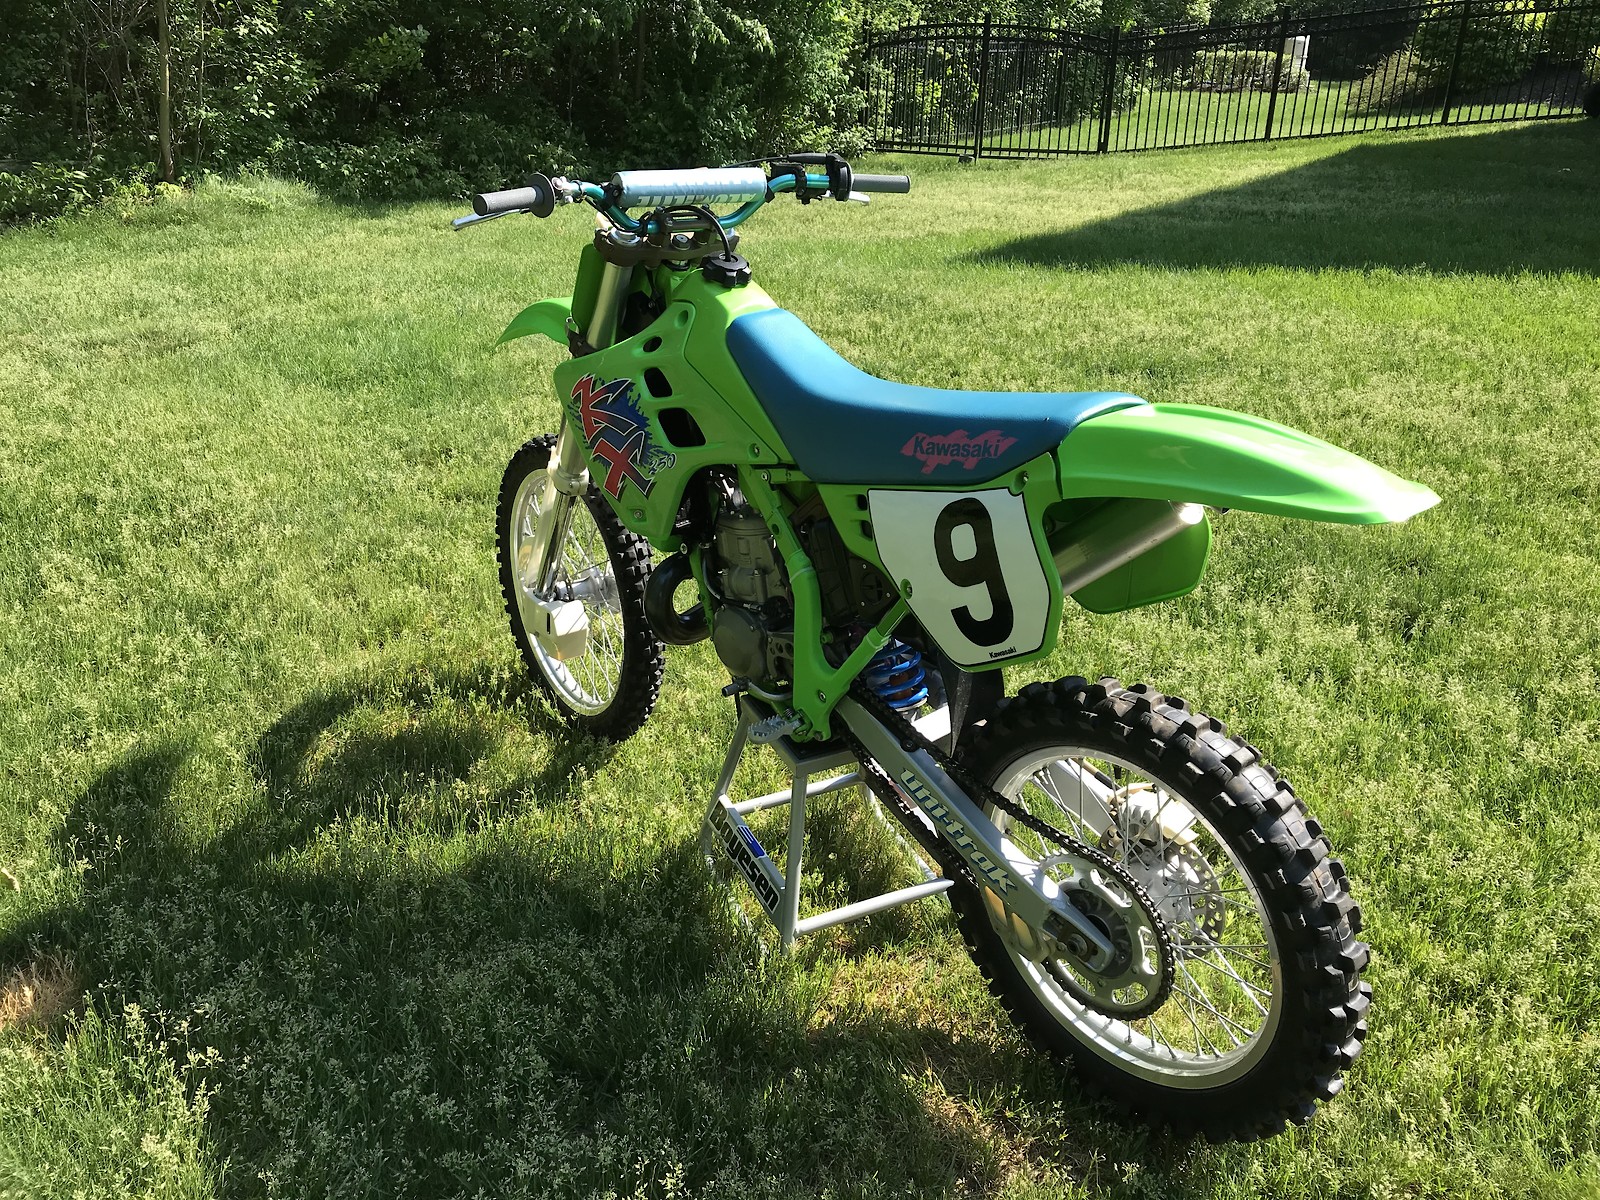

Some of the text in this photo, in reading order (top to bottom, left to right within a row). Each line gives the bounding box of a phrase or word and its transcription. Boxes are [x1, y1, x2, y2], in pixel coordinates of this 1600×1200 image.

[571, 372, 677, 500] KX 250
[912, 436, 1000, 458] Kawasaki
[933, 497, 1014, 647] 9
[988, 646, 1017, 659] Kawasaki
[708, 799, 780, 914] Boyesen
